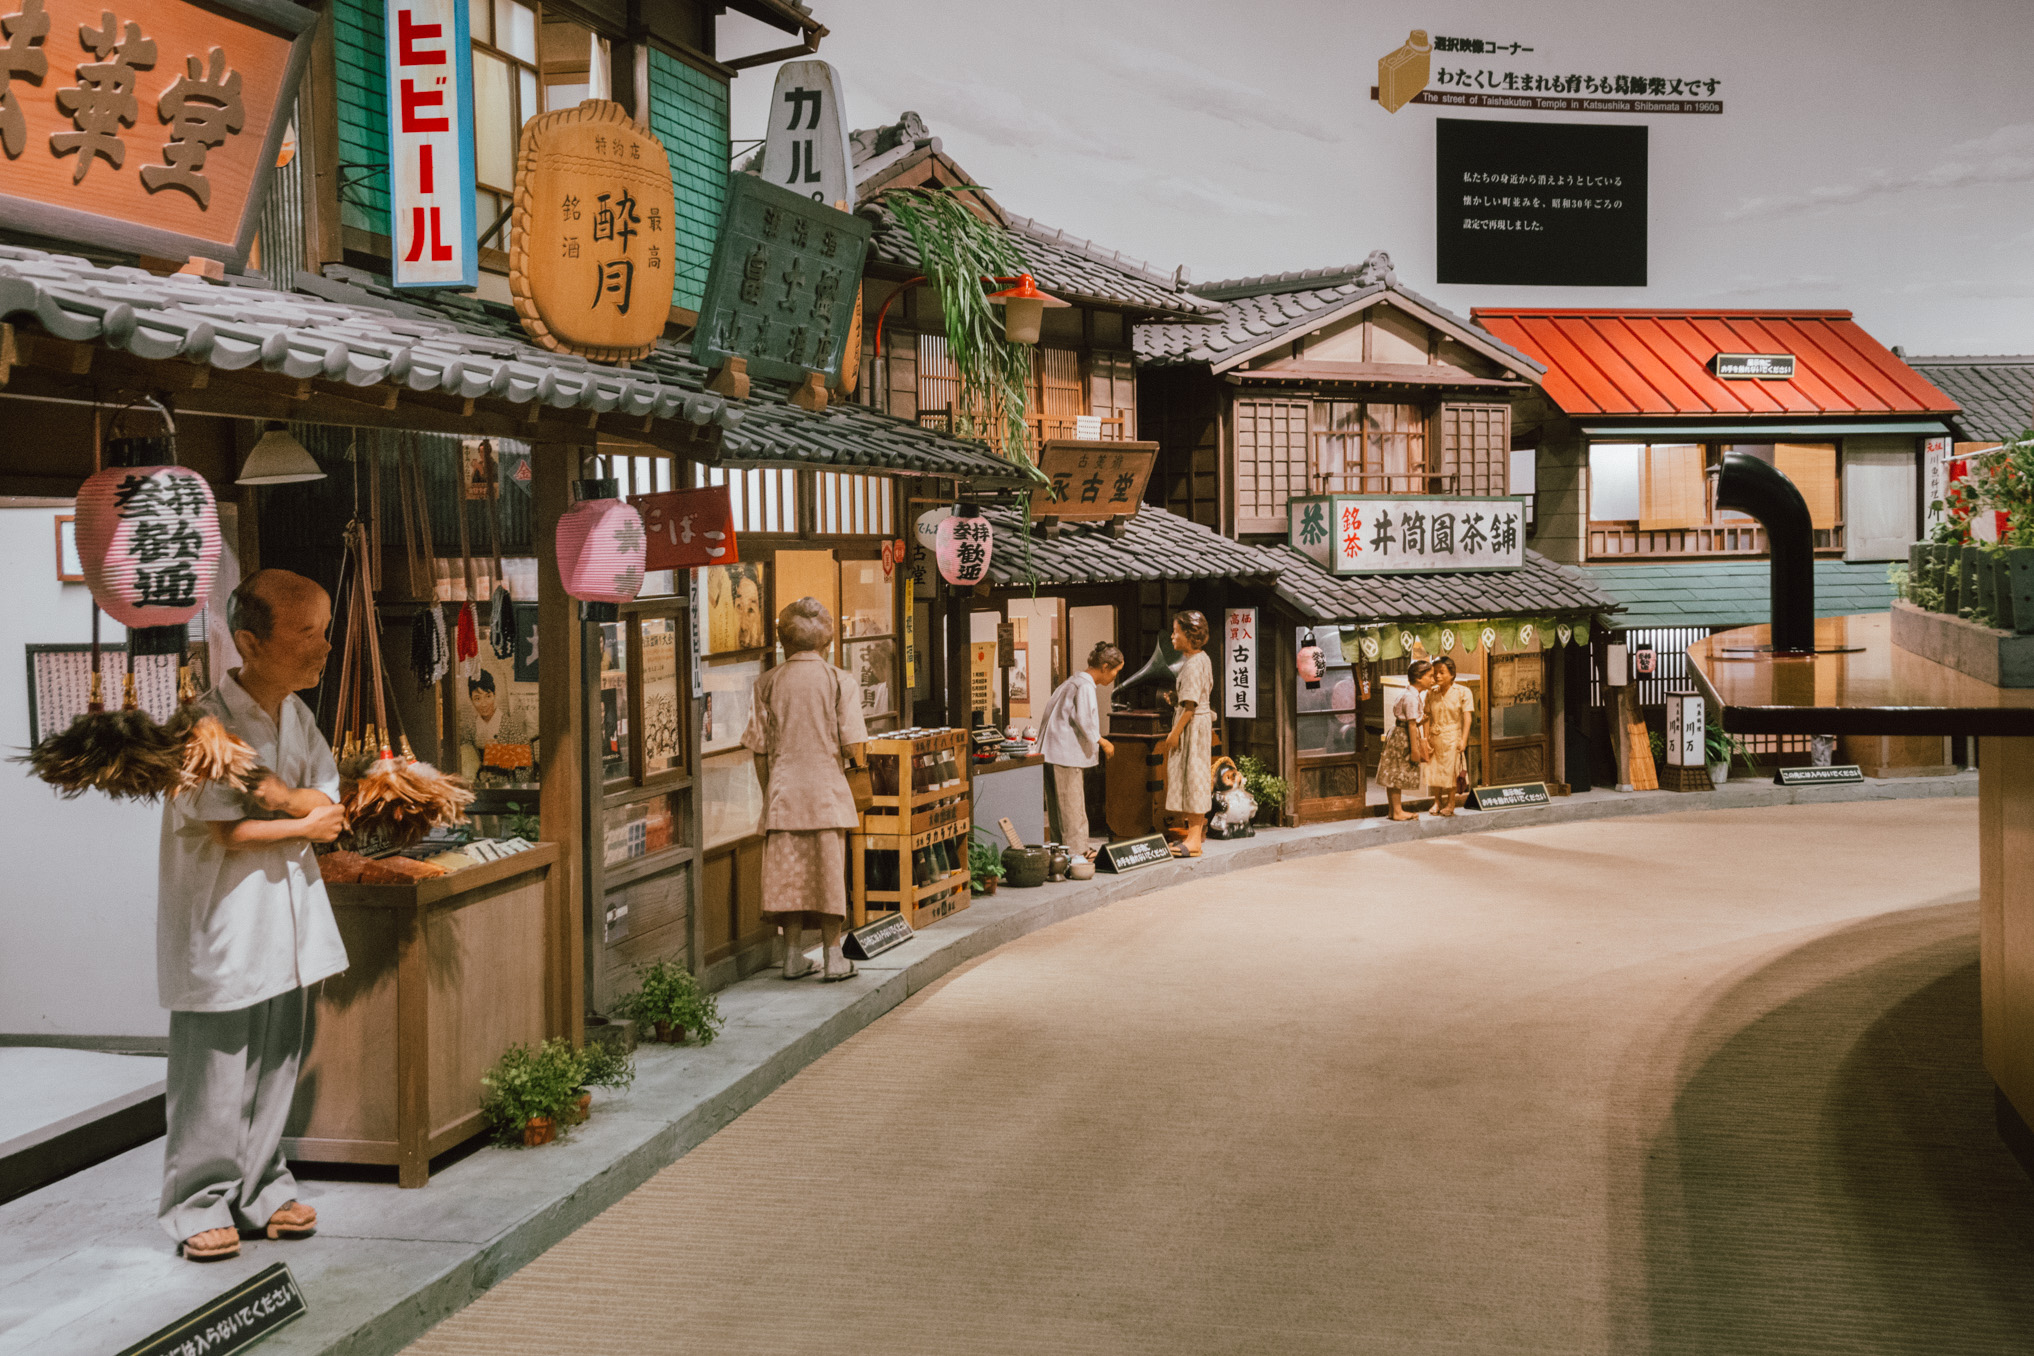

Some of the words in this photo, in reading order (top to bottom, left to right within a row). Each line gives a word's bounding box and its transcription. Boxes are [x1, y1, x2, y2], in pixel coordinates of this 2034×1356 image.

[1434, 36, 1534, 56] 選択映像コーナー
[1423, 91, 1439, 102] The
[1442, 94, 1466, 104] street
[1469, 94, 1478, 104] of
[1482, 95, 1532, 107] Taishakuten
[1537, 98, 1567, 110] Temple
[1571, 99, 1579, 108] in
[1583, 99, 1630, 110] Katsushika
[1634, 101, 1680, 111] Shibamata
[1684, 102, 1692, 111] in
[1695, 101, 1720, 112] 1960s
[1437, 67, 1721, 97] わたくし生まれも育ちも葛飾柴又です
[398, 9, 453, 262] ヒビール
[594, 136, 641, 161] 特約店
[784, 86, 825, 203] カル
[1463, 171, 1622, 186] 私たちの身近から消えようとしている
[561, 193, 582, 260] 銘酒
[647, 207, 662, 270] 最高
[1463, 218, 1544, 231] 設定で再現しました。
[1299, 503, 1329, 546] 茶
[1341, 506, 1363, 559] 銘茶
[1369, 508, 1519, 557] 井筒園茶舗
[1232, 644, 1250, 713] 古道具
